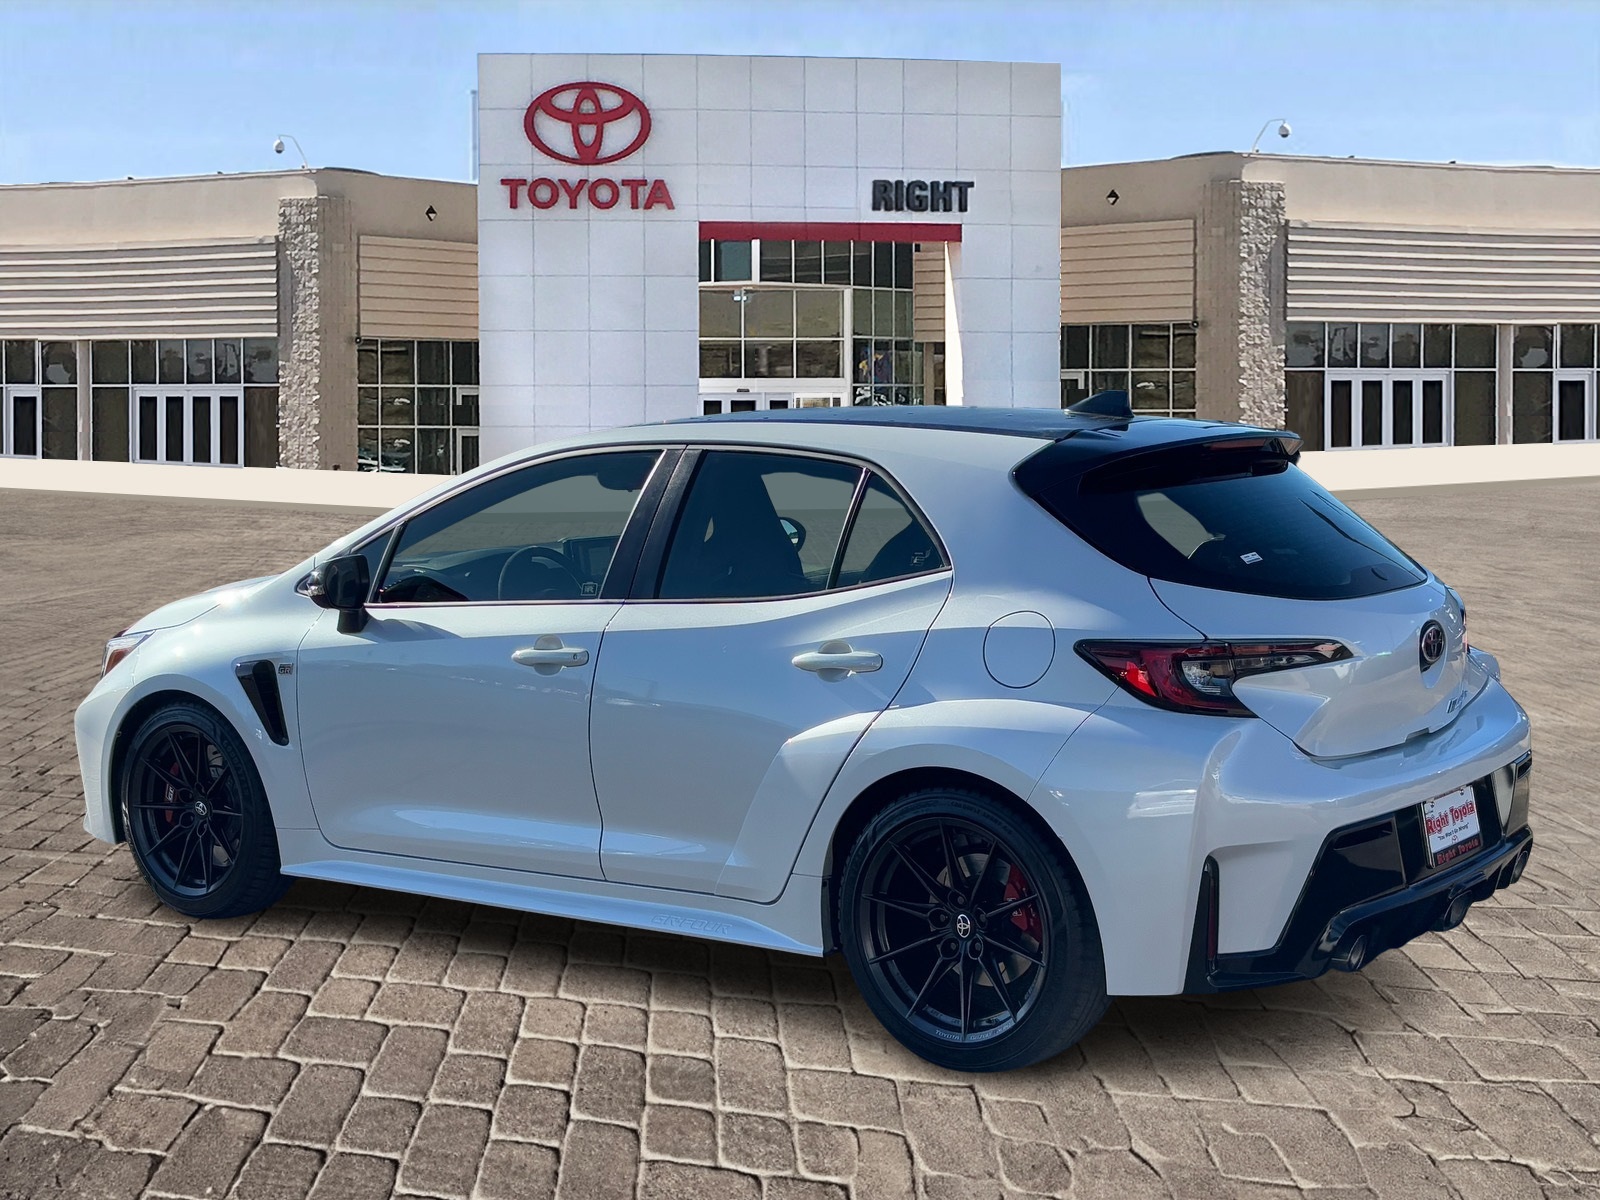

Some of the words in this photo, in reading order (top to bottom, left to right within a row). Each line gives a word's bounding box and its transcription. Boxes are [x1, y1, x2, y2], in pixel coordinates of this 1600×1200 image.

[501, 178, 676, 211] TOYOTA
[872, 179, 975, 212] RIGHT
[1425, 811, 1450, 835] Right
[1449, 800, 1475, 825] Toyota
[1437, 849, 1456, 865] Right
[1458, 838, 1480, 854] Toyota
[935, 1029, 960, 1040] TOYOTA
